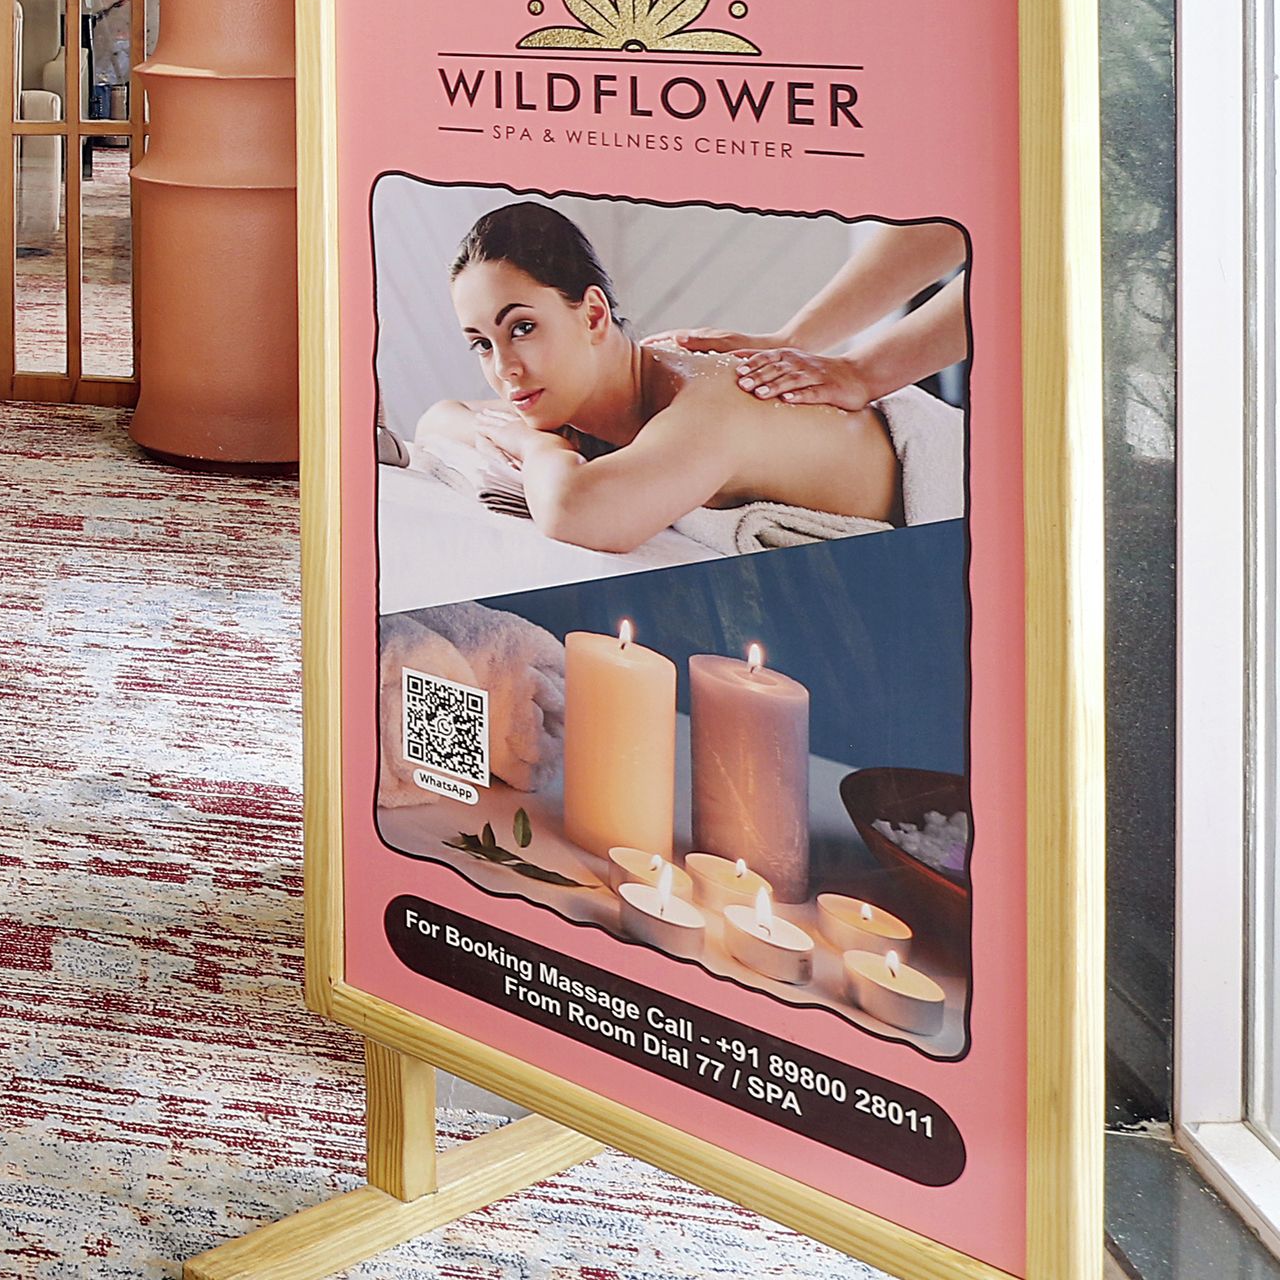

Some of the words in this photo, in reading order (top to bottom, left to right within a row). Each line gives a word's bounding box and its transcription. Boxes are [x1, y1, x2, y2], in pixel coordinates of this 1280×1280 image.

[438, 68, 864, 129] WILDFLOWER
[492, 125, 533, 141] SPA
[543, 128, 556, 144] &
[566, 130, 683, 152] WELLNESS
[695, 137, 793, 158] CENTER
[419, 772, 472, 800] WhatsApp
[405, 909, 440, 939] For
[445, 925, 533, 982] Booking
[539, 961, 641, 1020] Massage
[646, 1007, 693, 1042] Call
[716, 1036, 759, 1068] +91
[768, 1055, 847, 1102] 89800
[854, 1088, 933, 1138] 28011
[504, 975, 562, 1017] From
[568, 1001, 636, 1047] Room
[643, 1032, 689, 1069] Dial
[695, 1053, 726, 1082] 77
[747, 1075, 803, 1117] SPA
